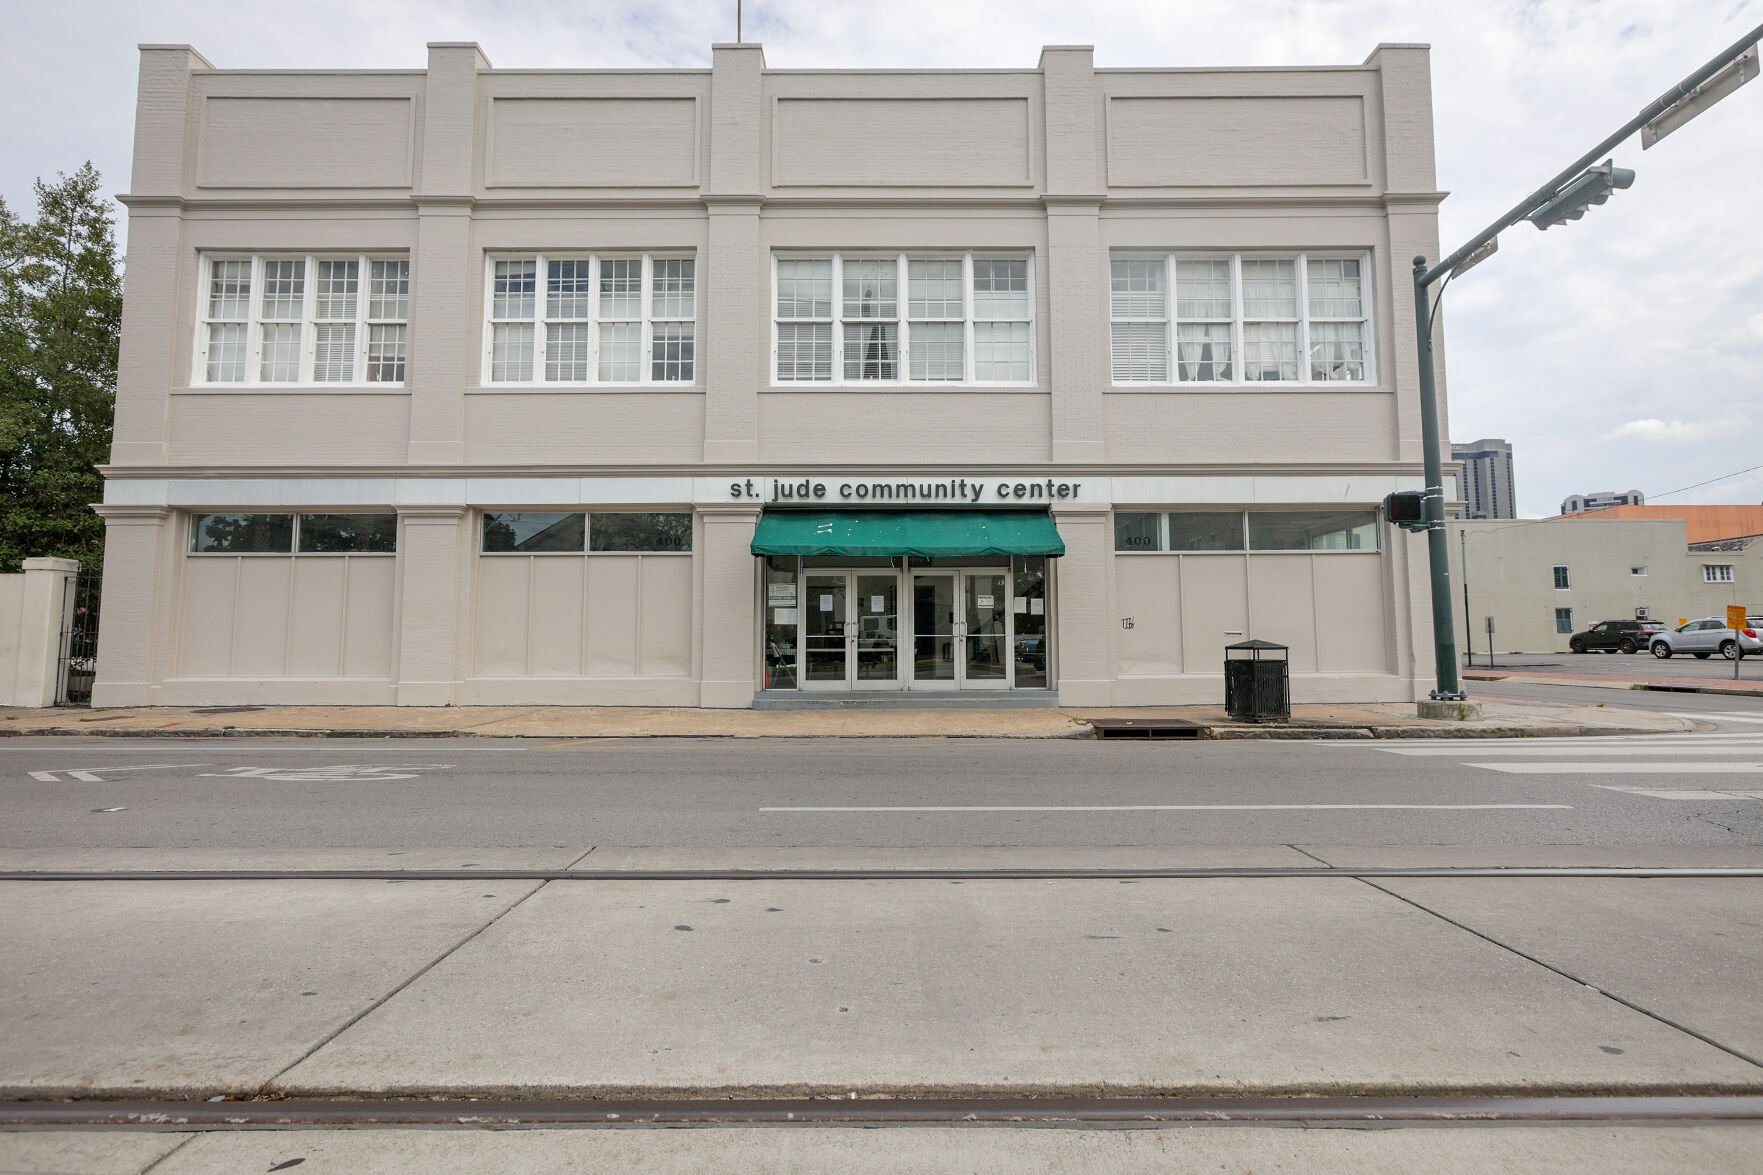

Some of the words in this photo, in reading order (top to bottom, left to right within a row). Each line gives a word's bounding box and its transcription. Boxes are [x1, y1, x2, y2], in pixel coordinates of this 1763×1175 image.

[730, 479, 760, 498] st.
[772, 479, 827, 502] jude
[839, 479, 984, 502] community
[996, 480, 1081, 499] center
[1125, 536, 1151, 546] 400
